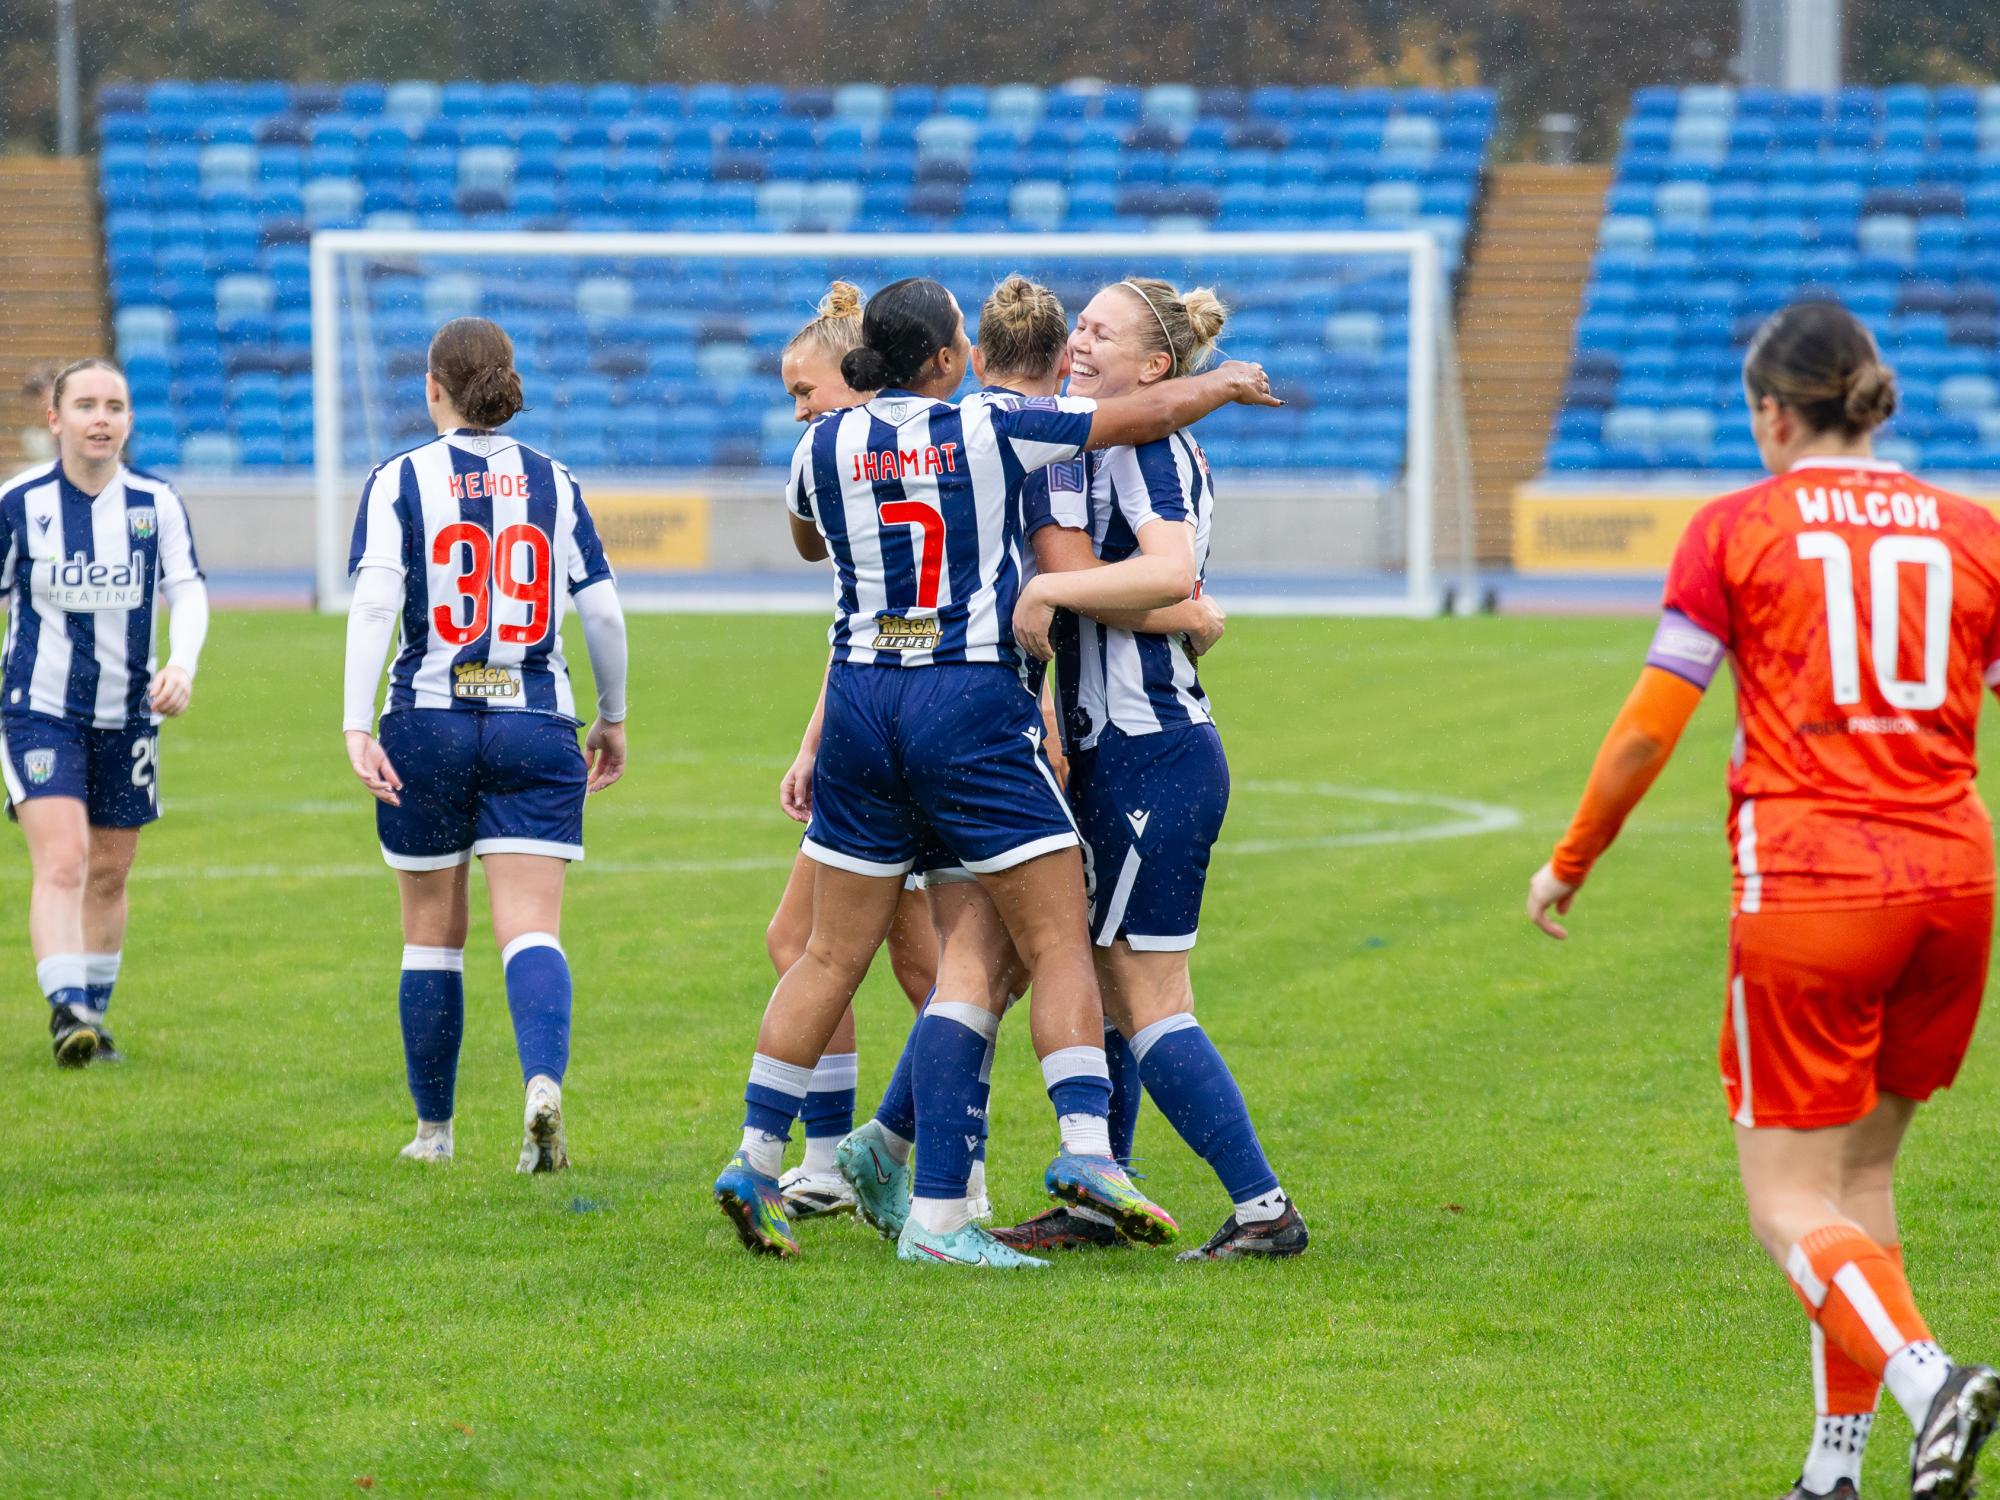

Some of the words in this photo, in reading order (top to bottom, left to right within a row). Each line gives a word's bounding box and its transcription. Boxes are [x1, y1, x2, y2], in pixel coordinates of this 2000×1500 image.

[852, 442, 957, 482] JHAMAT
[449, 472, 531, 499] KEHOE
[1795, 486, 1940, 531] WILCOX
[48, 553, 142, 587] ideal
[878, 500, 945, 608] 7
[48, 590, 141, 603] HEATING
[431, 521, 551, 646] 39
[882, 618, 937, 635] MEGA
[1796, 531, 1953, 710] 10
[877, 636, 934, 649] RICHES
[458, 667, 513, 684] MEGA
